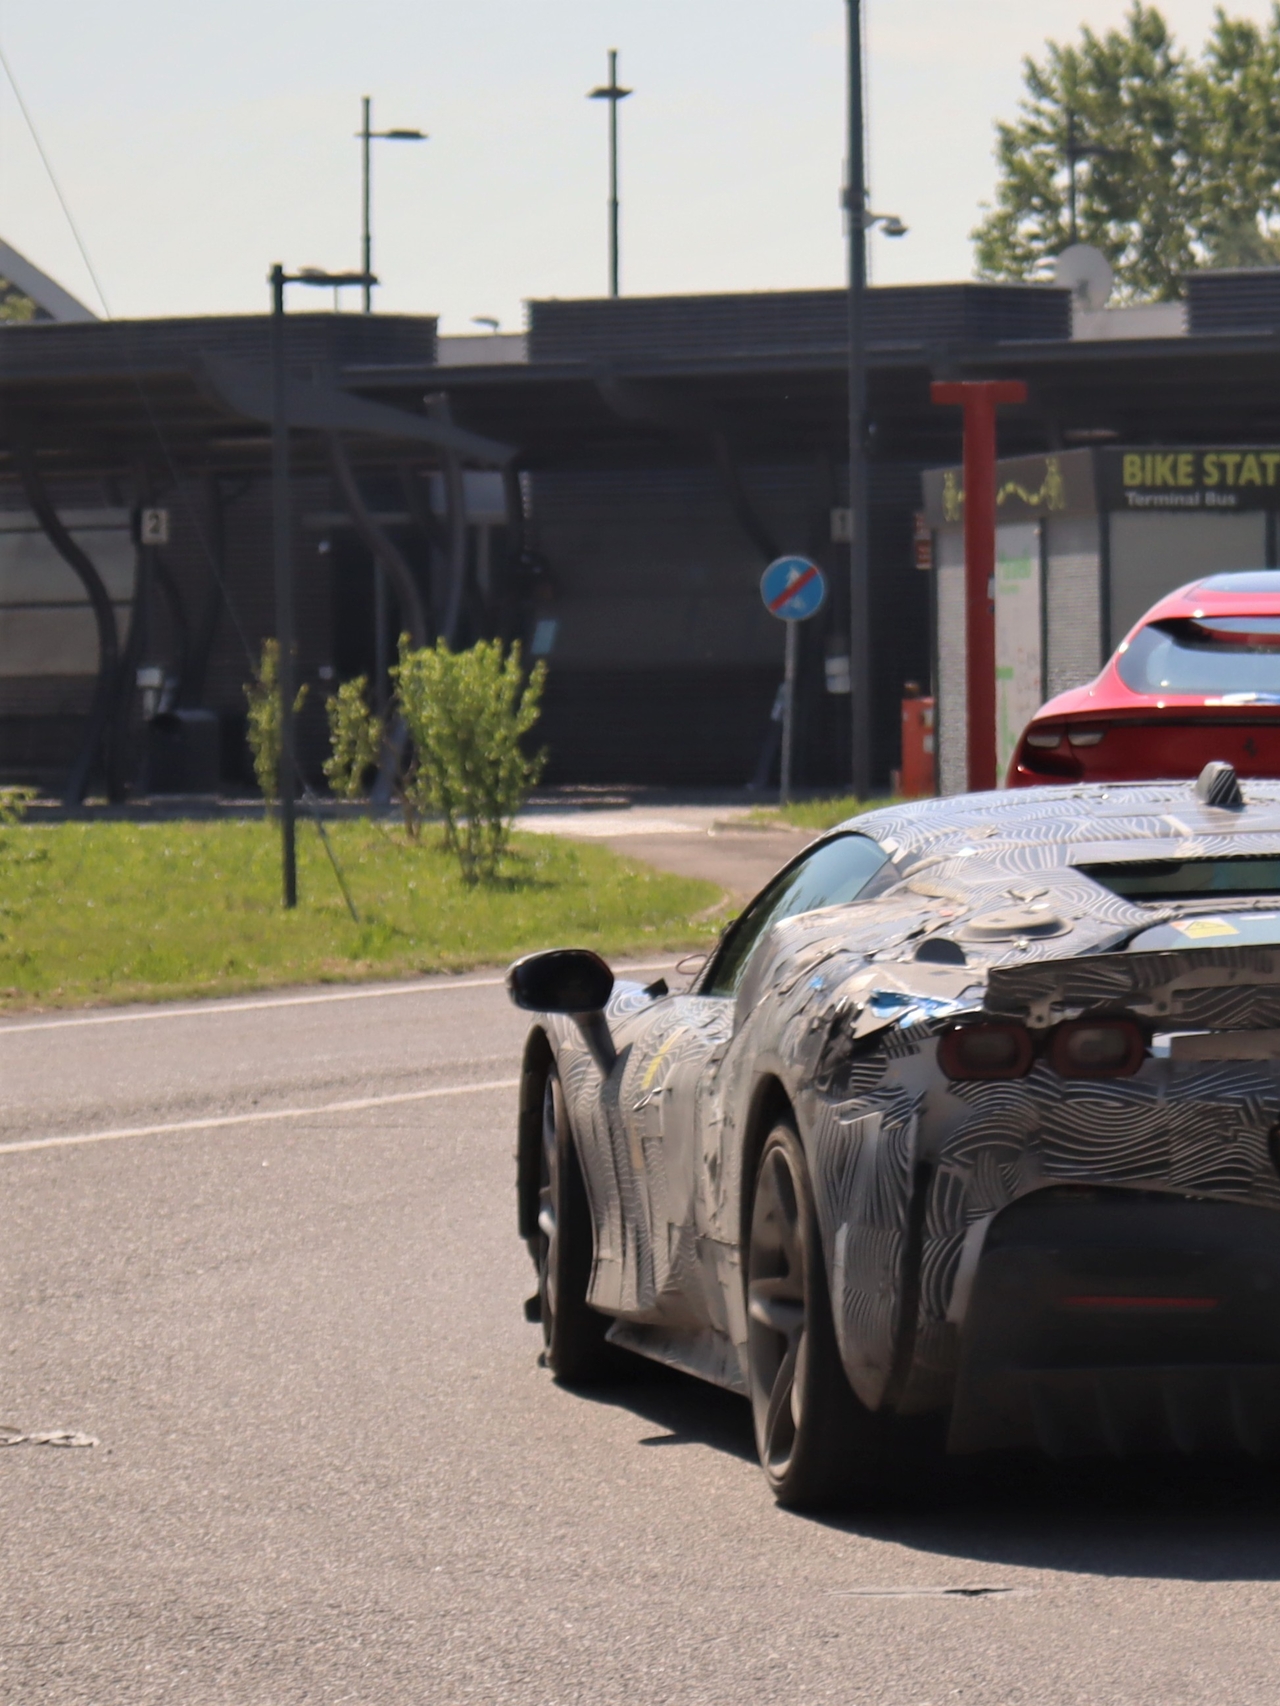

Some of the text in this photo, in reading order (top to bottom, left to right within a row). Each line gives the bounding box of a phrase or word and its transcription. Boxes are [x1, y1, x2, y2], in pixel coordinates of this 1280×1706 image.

[1122, 453, 1194, 487] BIKE
[1125, 491, 1236, 507] Terminal Bus
[148, 512, 161, 534] 2
